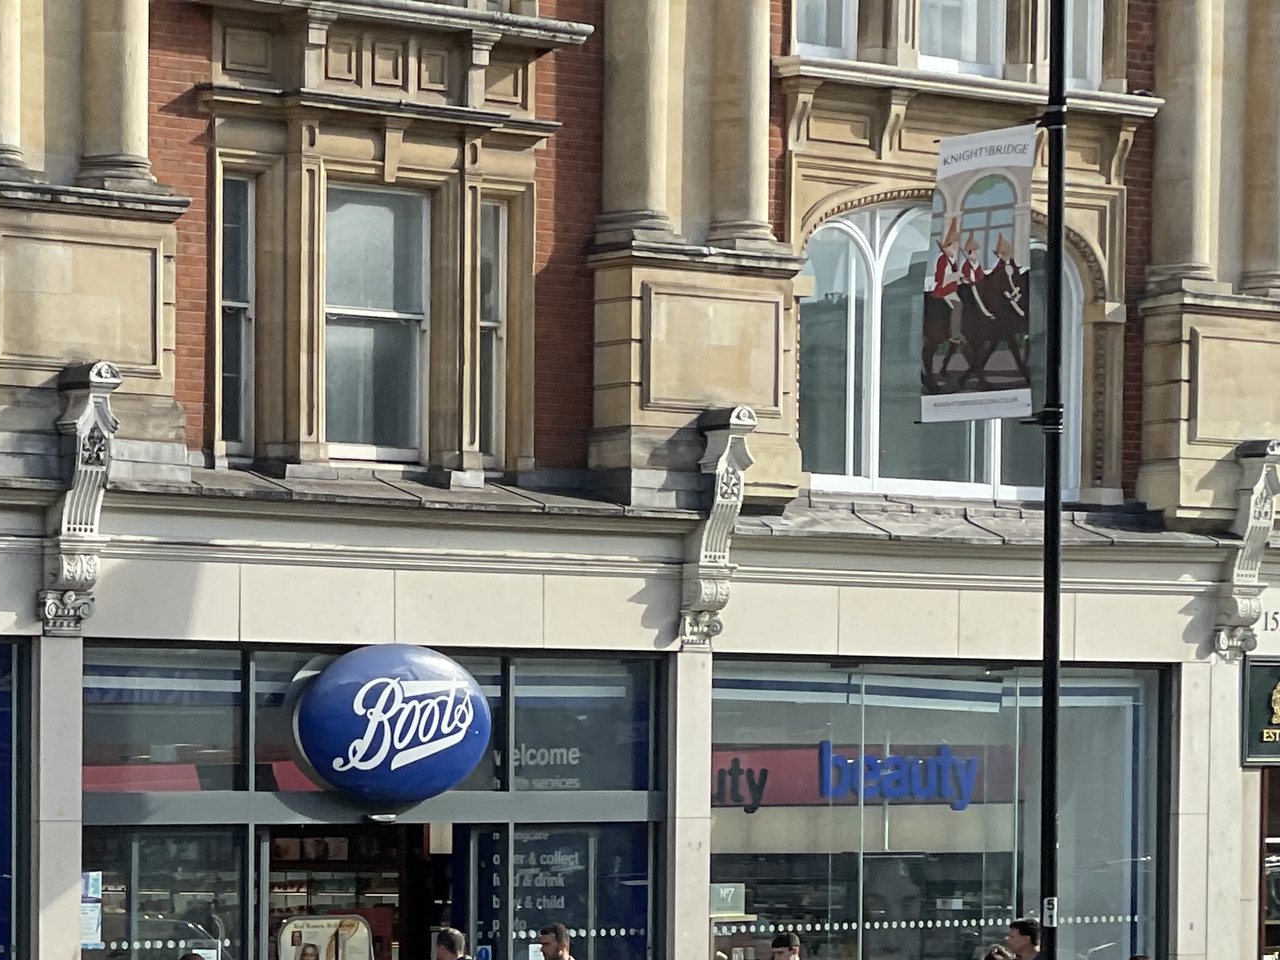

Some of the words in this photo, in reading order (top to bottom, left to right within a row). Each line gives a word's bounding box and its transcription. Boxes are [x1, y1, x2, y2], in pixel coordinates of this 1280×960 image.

[943, 143, 1030, 166] KNIGHTSBRIDGE
[332, 677, 474, 772] Boots
[818, 739, 979, 811] beauty
[1046, 899, 1055, 911] 5
